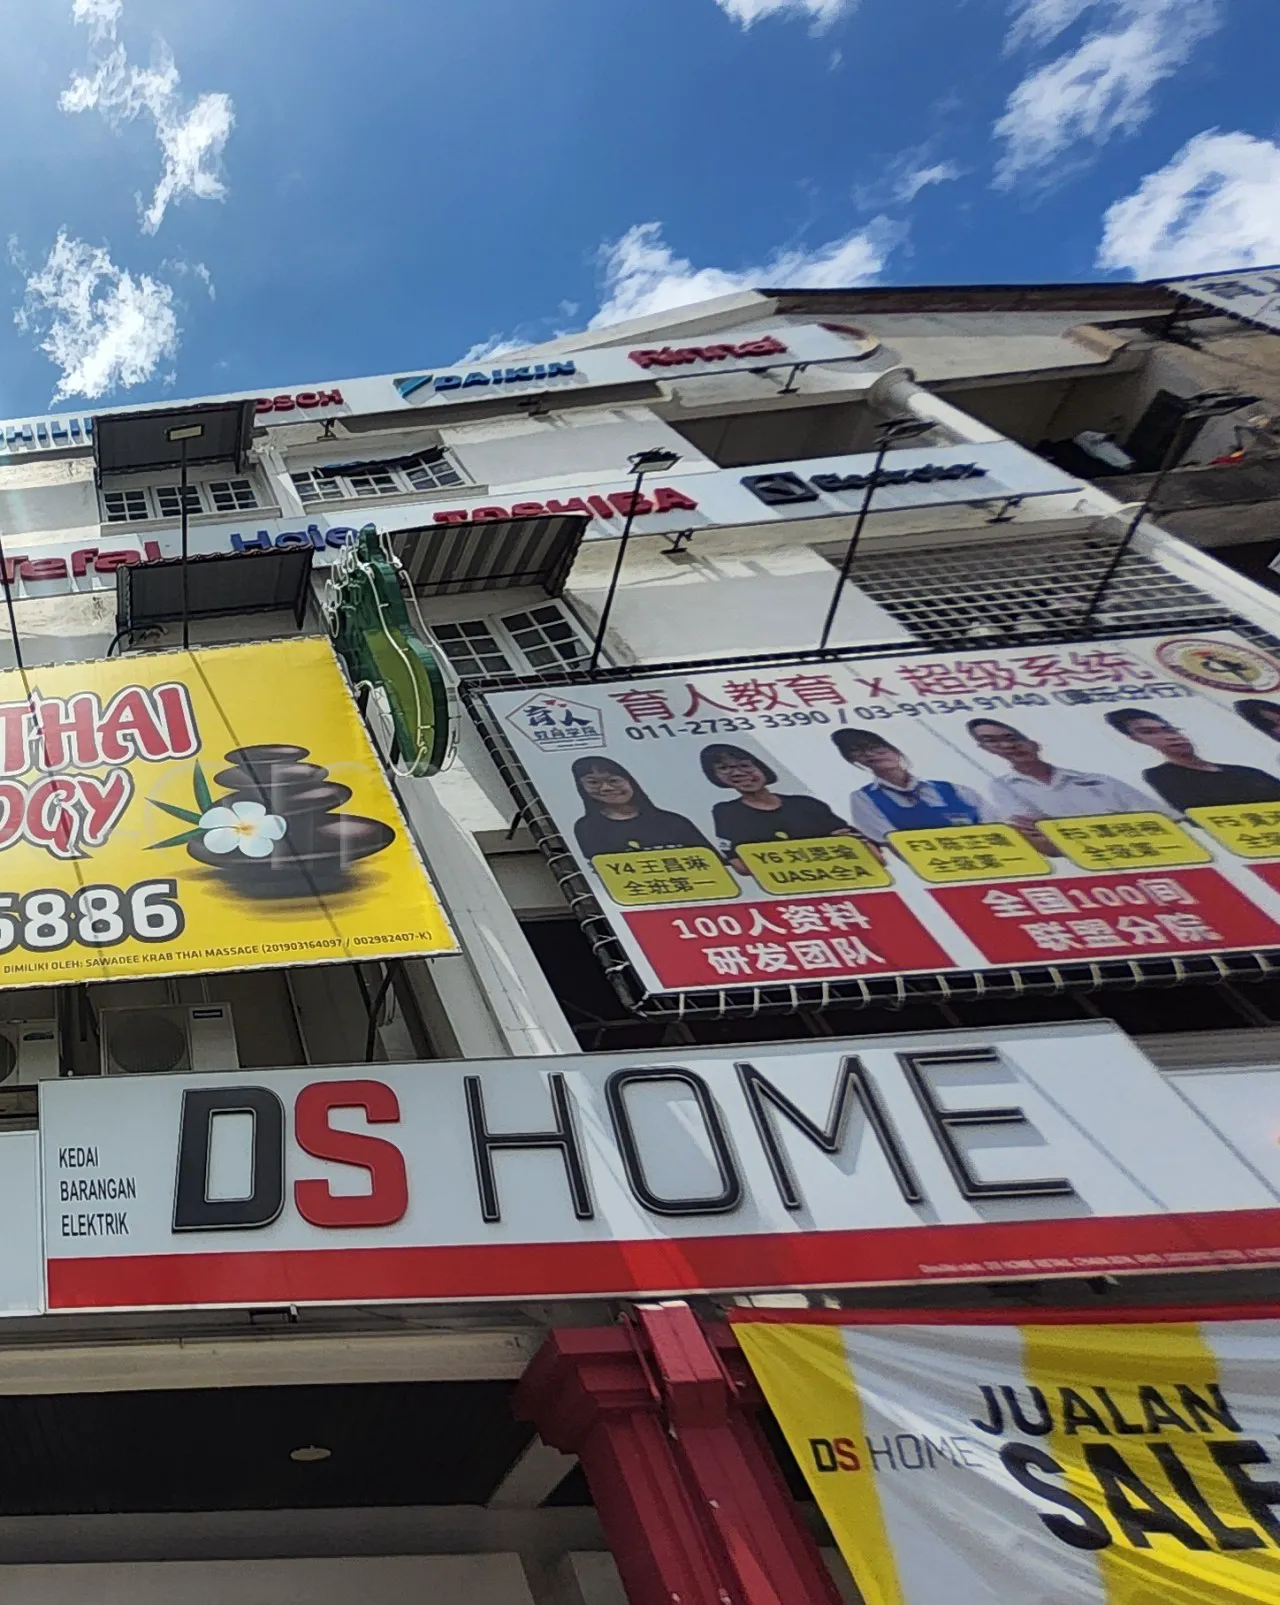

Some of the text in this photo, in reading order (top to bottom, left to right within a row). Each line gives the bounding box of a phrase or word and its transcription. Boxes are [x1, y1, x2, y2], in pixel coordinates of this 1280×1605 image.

[433, 361, 576, 391] DAIKIN
[255, 389, 345, 413] OSCH
[231, 524, 359, 552] Haie
[608, 673, 849, 724] 育人教育
[896, 649, 1157, 696] 超级系统
[523, 705, 593, 727] 育人
[625, 716, 756, 741] 011-2733
[763, 709, 831, 729] 3390
[840, 708, 849, 725] /
[854, 700, 972, 721] 03-9134
[607, 860, 637, 876] Y4
[752, 850, 782, 866] Y6
[622, 876, 718, 897] 全班第一
[771, 864, 875, 885] UASA全A
[981, 878, 1200, 919] 全国100间
[672, 900, 871, 940] 100人资料
[1020, 911, 1227, 952] 联盟分院
[3, 962, 50, 975] DIMILIKI
[51, 960, 83, 972] OLEH:
[85, 953, 140, 968] SAWADEE
[142, 951, 174, 964] KRAB
[174, 948, 203, 961] THAI
[204, 944, 260, 959] MASSAGE
[261, 938, 344, 956] (201903164097
[353, 930, 433, 947] 002982407-K)
[701, 935, 886, 976] 研发团队
[172, 1045, 1076, 1234] DS HOME
[59, 1146, 99, 1169] KEDAI
[60, 1177, 137, 1202] BARANGAN
[61, 1211, 130, 1237] ELEKTRIK
[971, 1383, 1244, 1437] JUALAN
[808, 1432, 986, 1474] DS HOME
